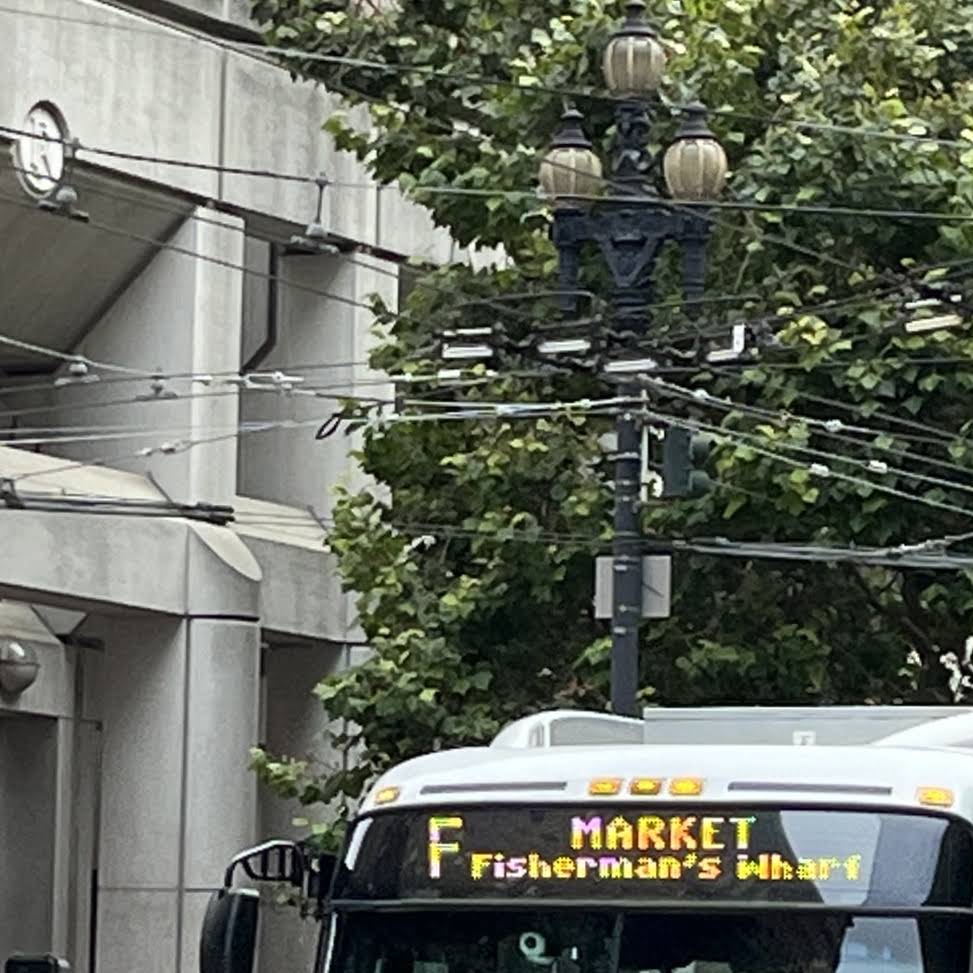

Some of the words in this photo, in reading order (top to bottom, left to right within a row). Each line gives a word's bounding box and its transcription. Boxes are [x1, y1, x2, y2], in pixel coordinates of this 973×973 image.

[429, 816, 463, 879] F
[570, 815, 756, 850] MARKET
[470, 851, 722, 879] Fisherman's
[735, 853, 861, 880] Wharf
